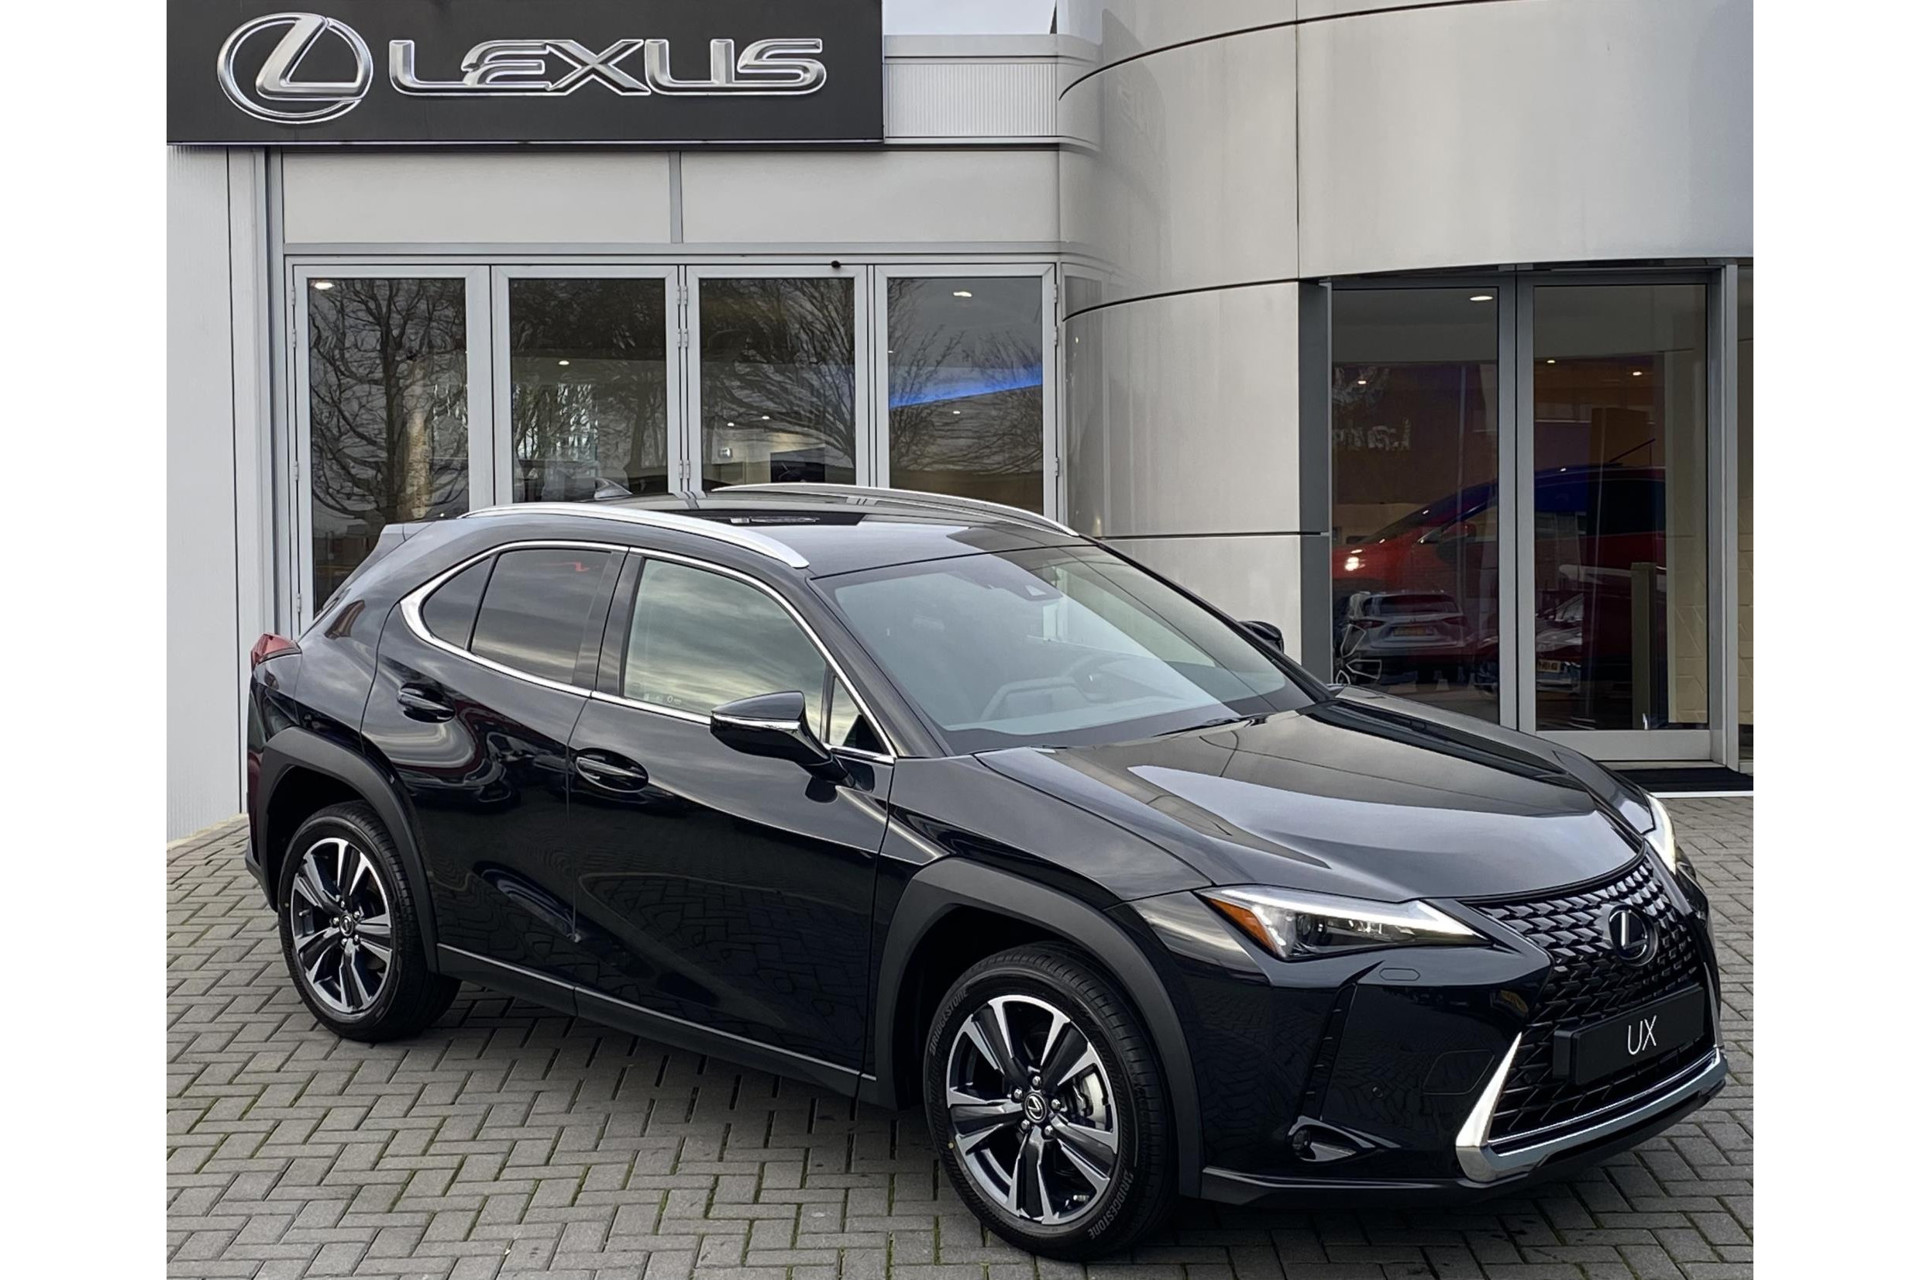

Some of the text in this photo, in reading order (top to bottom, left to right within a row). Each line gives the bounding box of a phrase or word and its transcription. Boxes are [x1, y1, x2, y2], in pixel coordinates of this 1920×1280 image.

[388, 38, 827, 96] LEXUS
[929, 989, 969, 1056] BRIDGESTONE
[1627, 1015, 1657, 1055] UX
[1088, 1169, 1134, 1239] BRIDGESTONE
